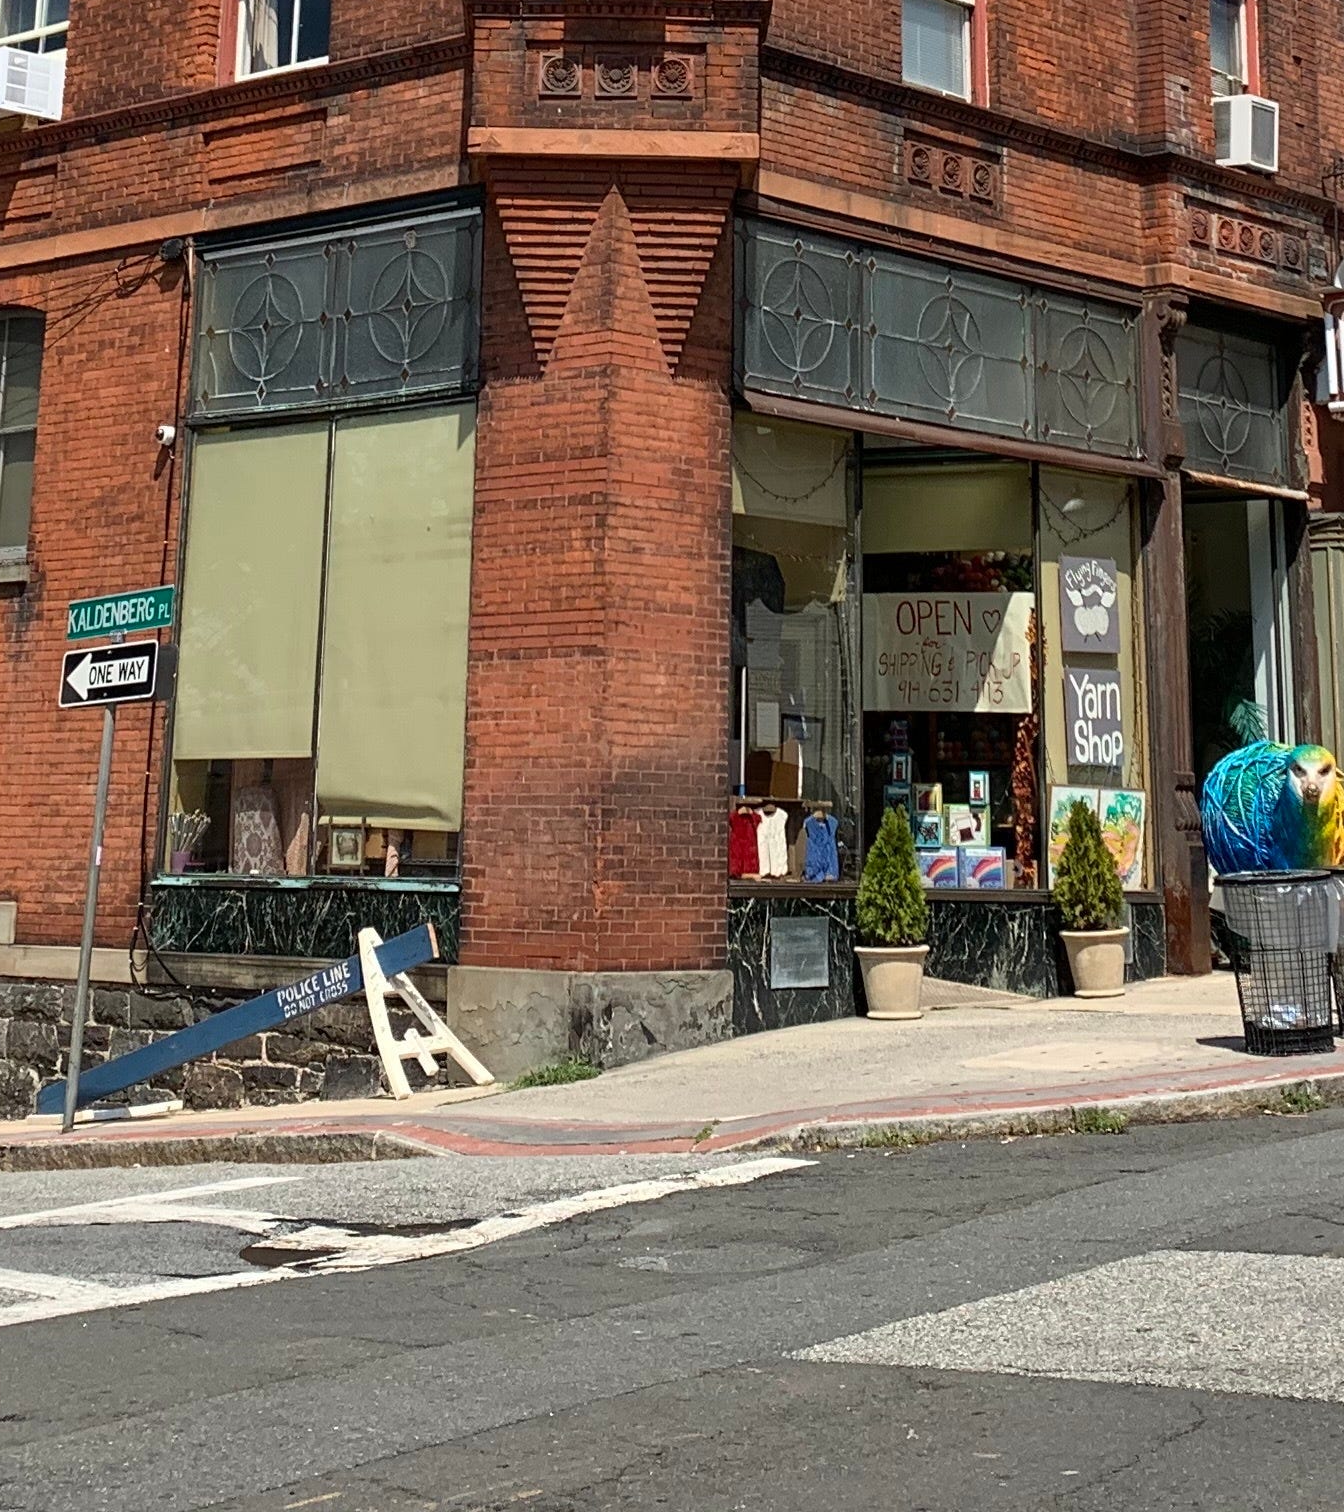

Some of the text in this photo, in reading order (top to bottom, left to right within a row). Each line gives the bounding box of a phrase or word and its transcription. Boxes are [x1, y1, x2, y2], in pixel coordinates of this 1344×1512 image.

[1065, 562, 1091, 588] Flying
[67, 596, 170, 633] KALDENBERG PL
[896, 600, 972, 635] OPEN
[89, 659, 145, 686] ONE WAY
[1069, 674, 1121, 721] Yarn
[1074, 719, 1123, 765] Shop
[277, 962, 351, 1007] POLICE LINE
[283, 980, 348, 1019] DO NOT CROSS
